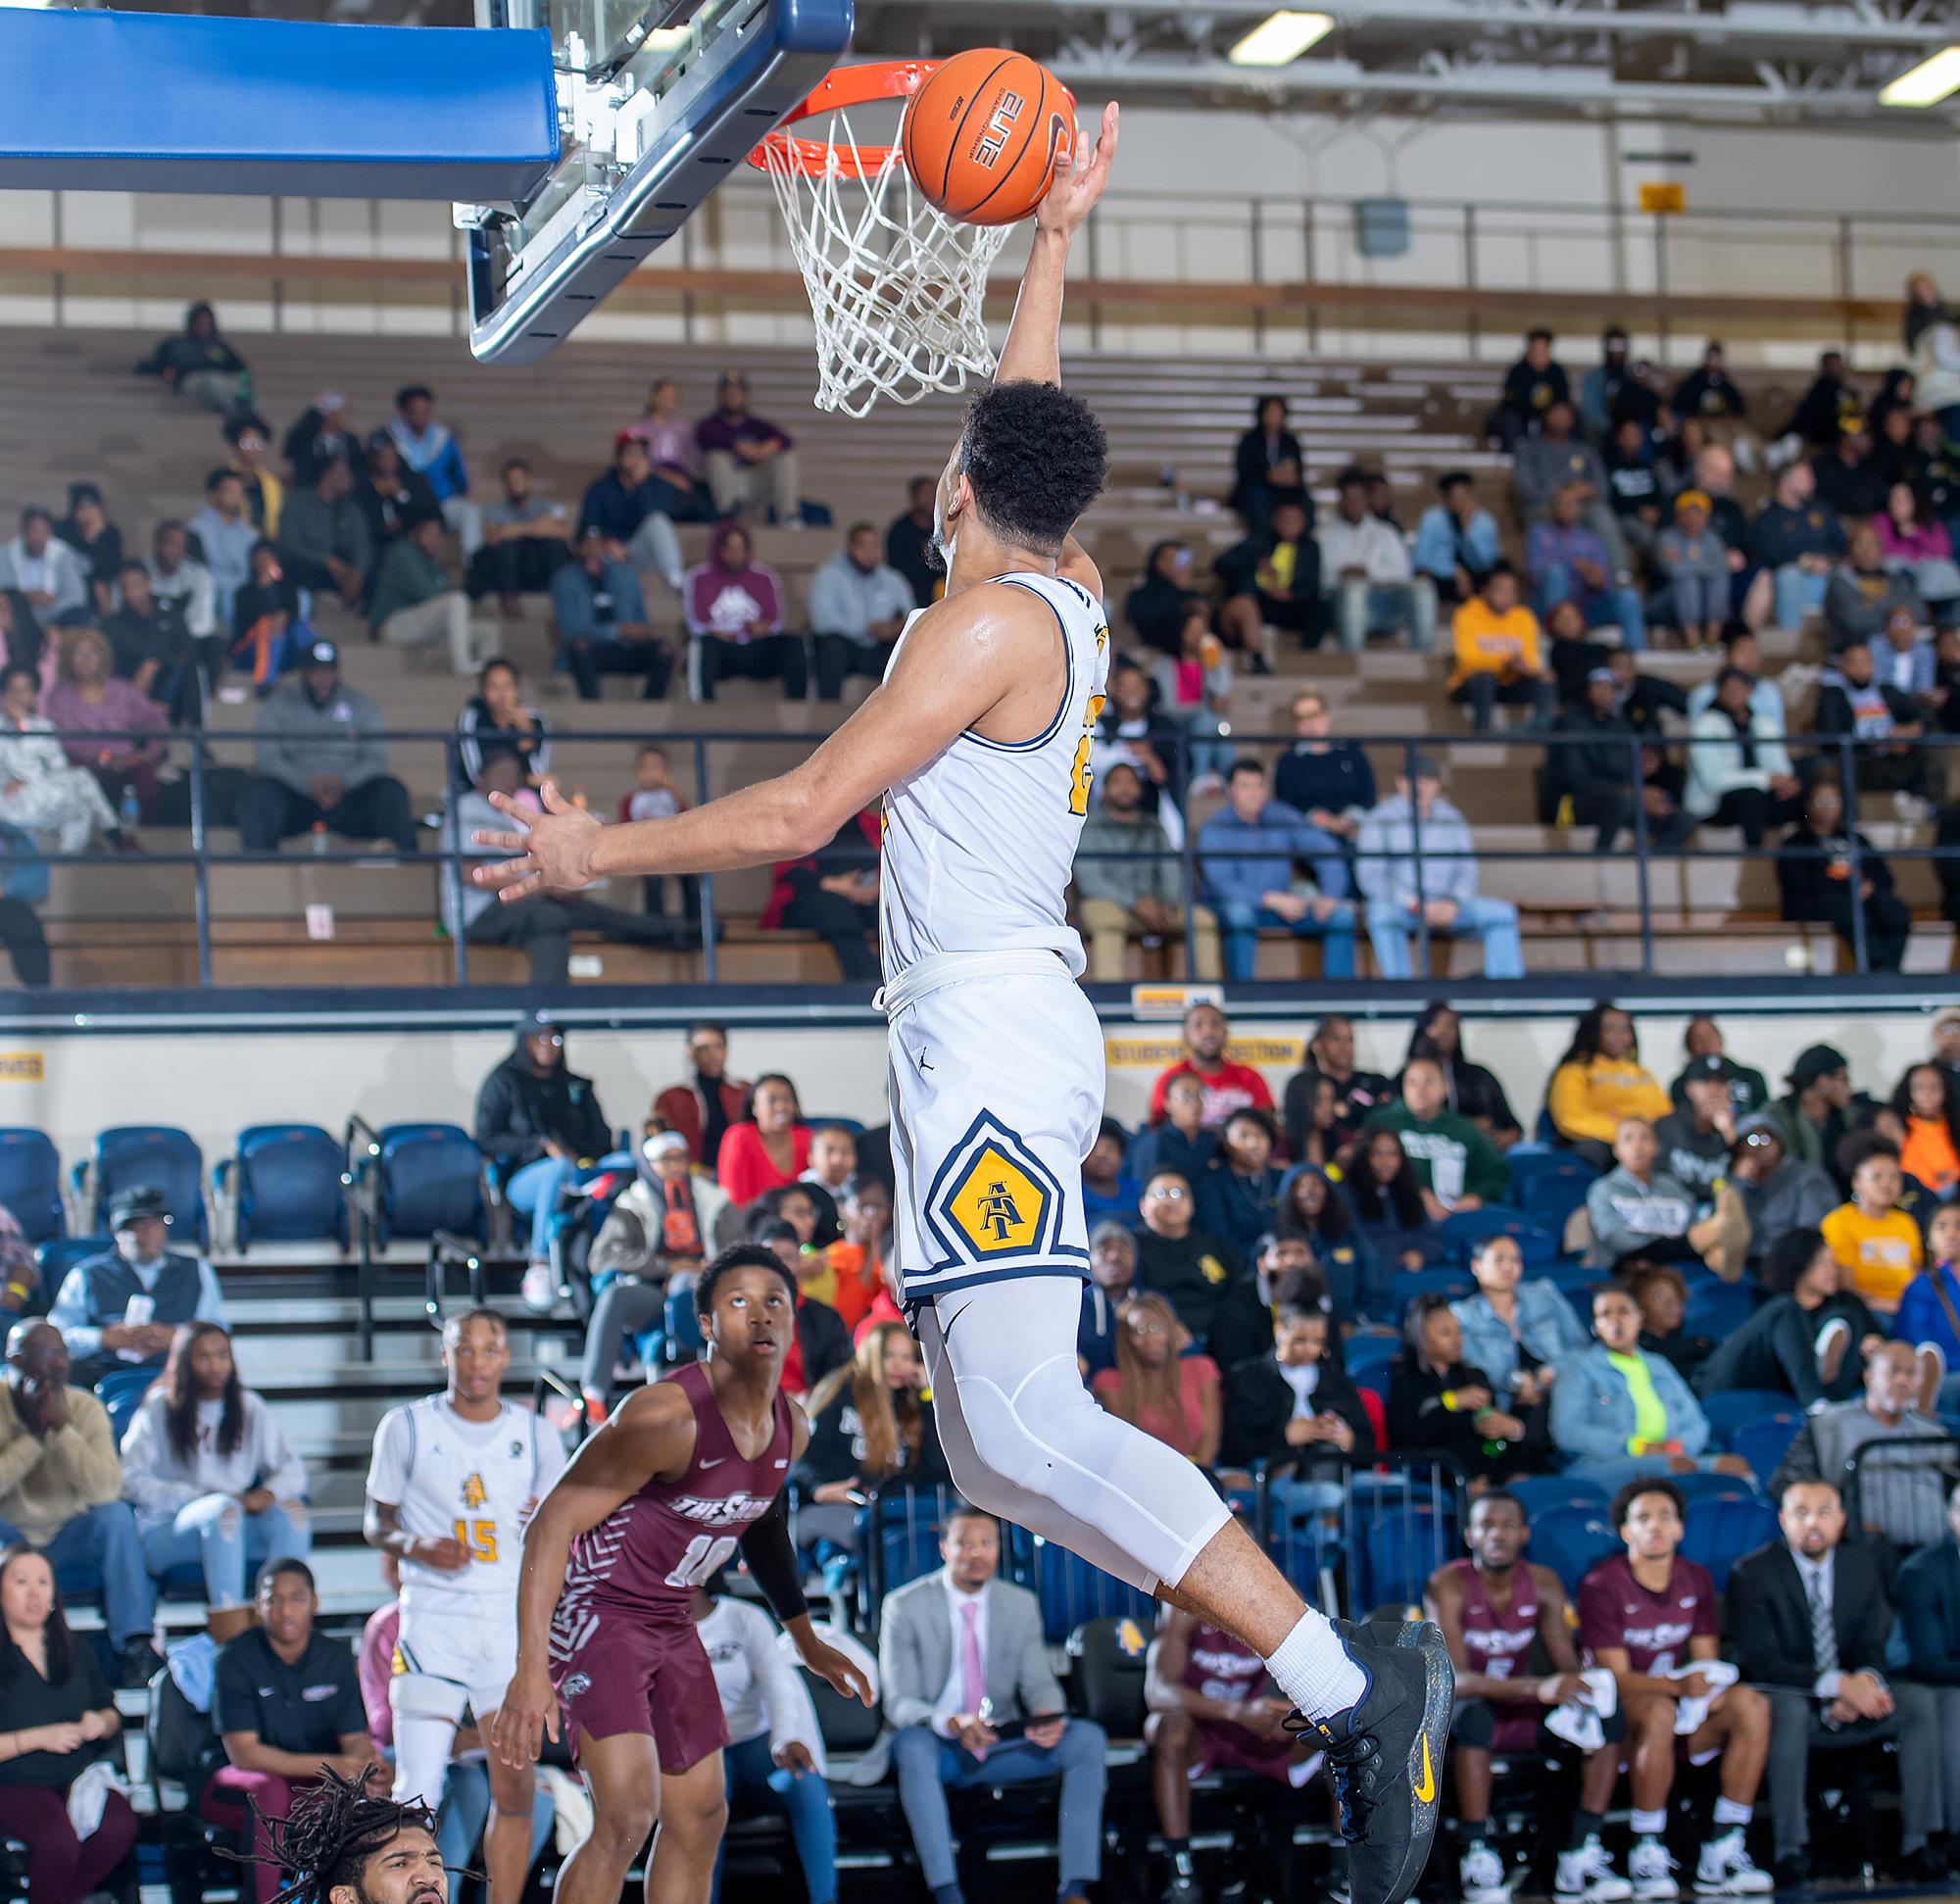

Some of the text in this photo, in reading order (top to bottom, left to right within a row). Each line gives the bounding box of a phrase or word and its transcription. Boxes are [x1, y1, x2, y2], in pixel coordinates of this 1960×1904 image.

[968, 87, 1005, 159] CHAMPIONSHIP
[973, 90, 1026, 171] ELITE
[454, 1519, 498, 1563] 15
